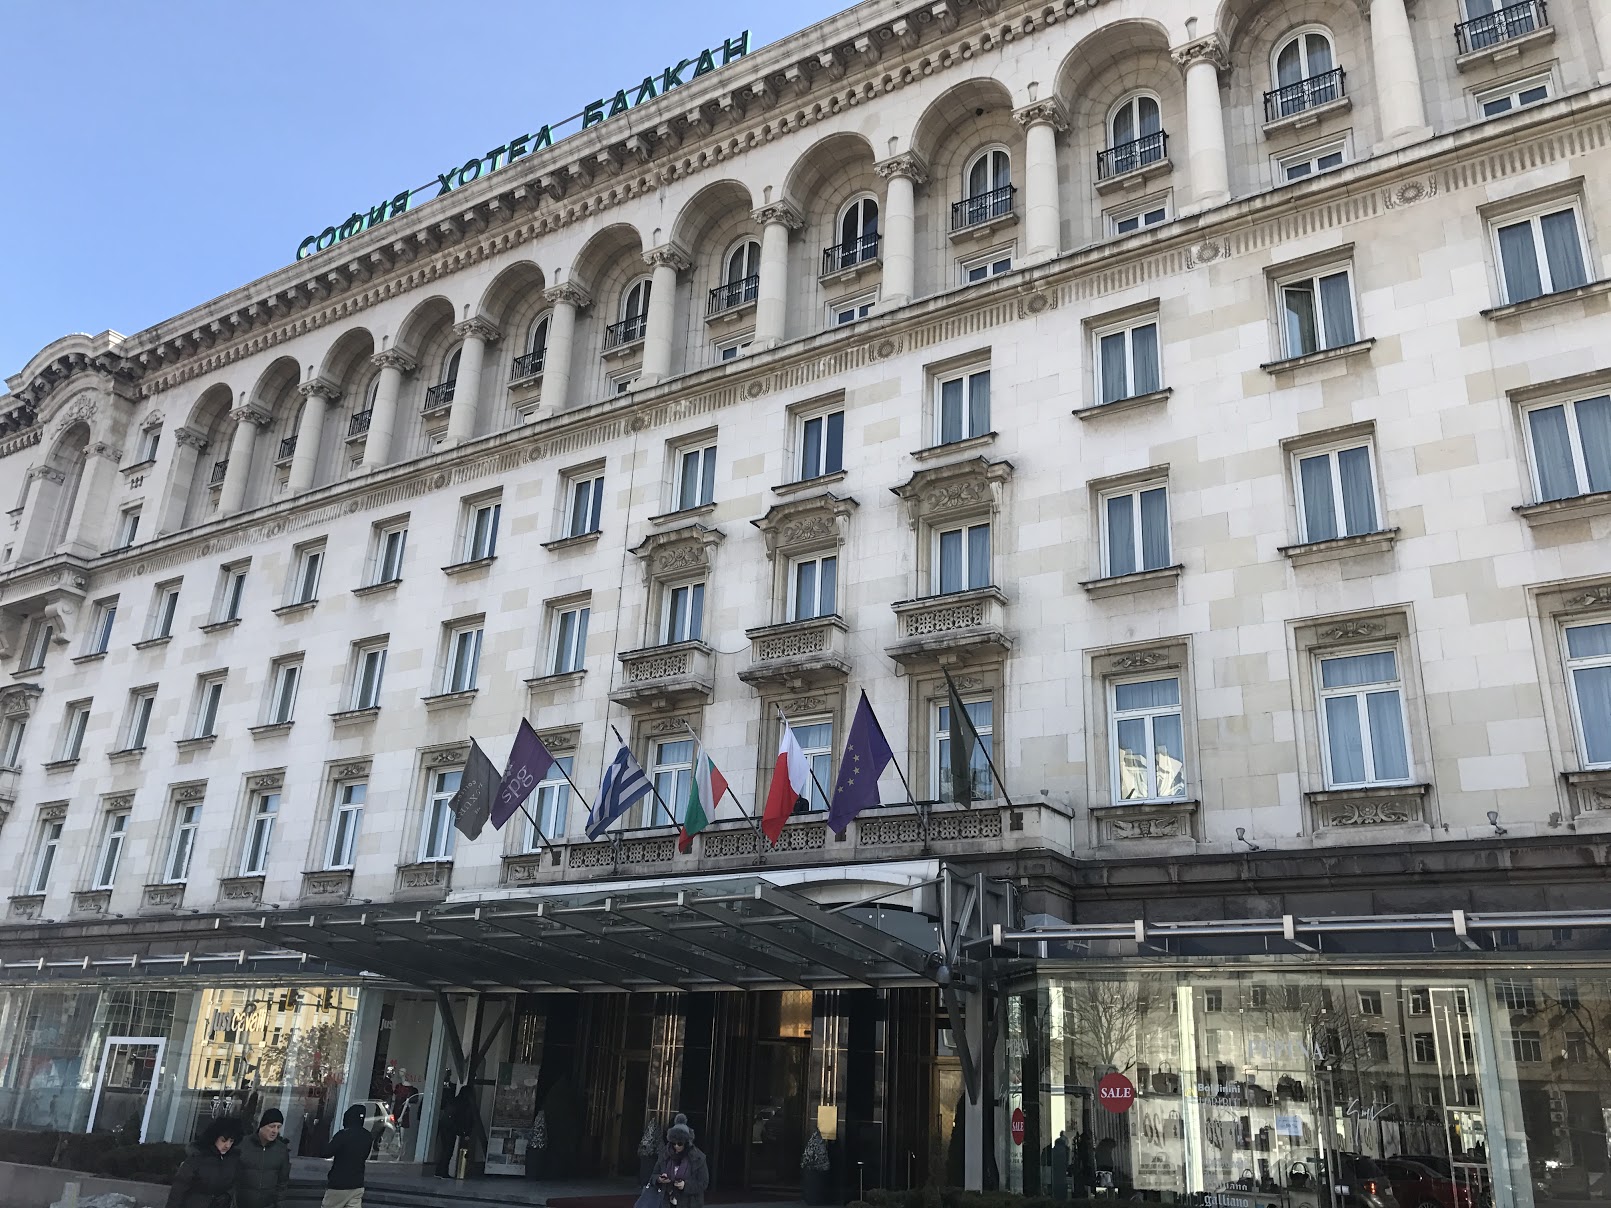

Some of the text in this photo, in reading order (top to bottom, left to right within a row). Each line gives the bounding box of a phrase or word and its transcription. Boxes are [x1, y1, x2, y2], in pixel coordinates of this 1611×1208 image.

[296, 30, 752, 261] СОФИЯ ХОТЕЛ БАЛКАН
[501, 765, 534, 804] spg
[1100, 1087, 1132, 1099] SALE
[1011, 1121, 1025, 1132] SALE
